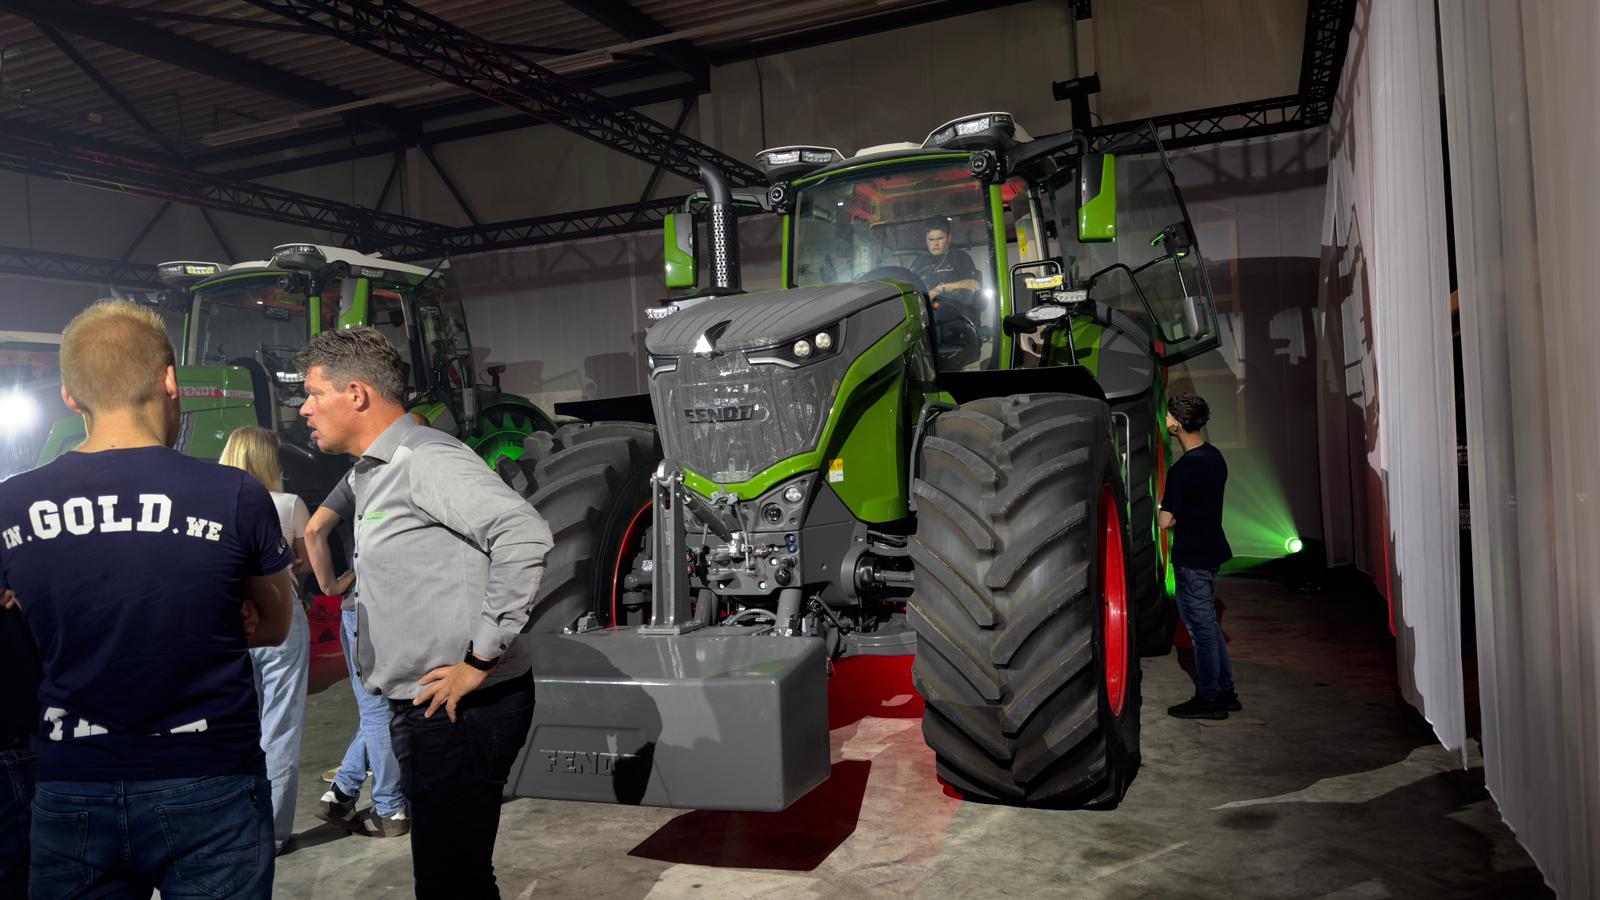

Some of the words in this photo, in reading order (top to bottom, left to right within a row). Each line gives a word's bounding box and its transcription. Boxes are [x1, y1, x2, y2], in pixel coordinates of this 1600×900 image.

[683, 403, 754, 424] FENDT
[186, 516, 223, 542] WE
[539, 749, 640, 776] FEND
